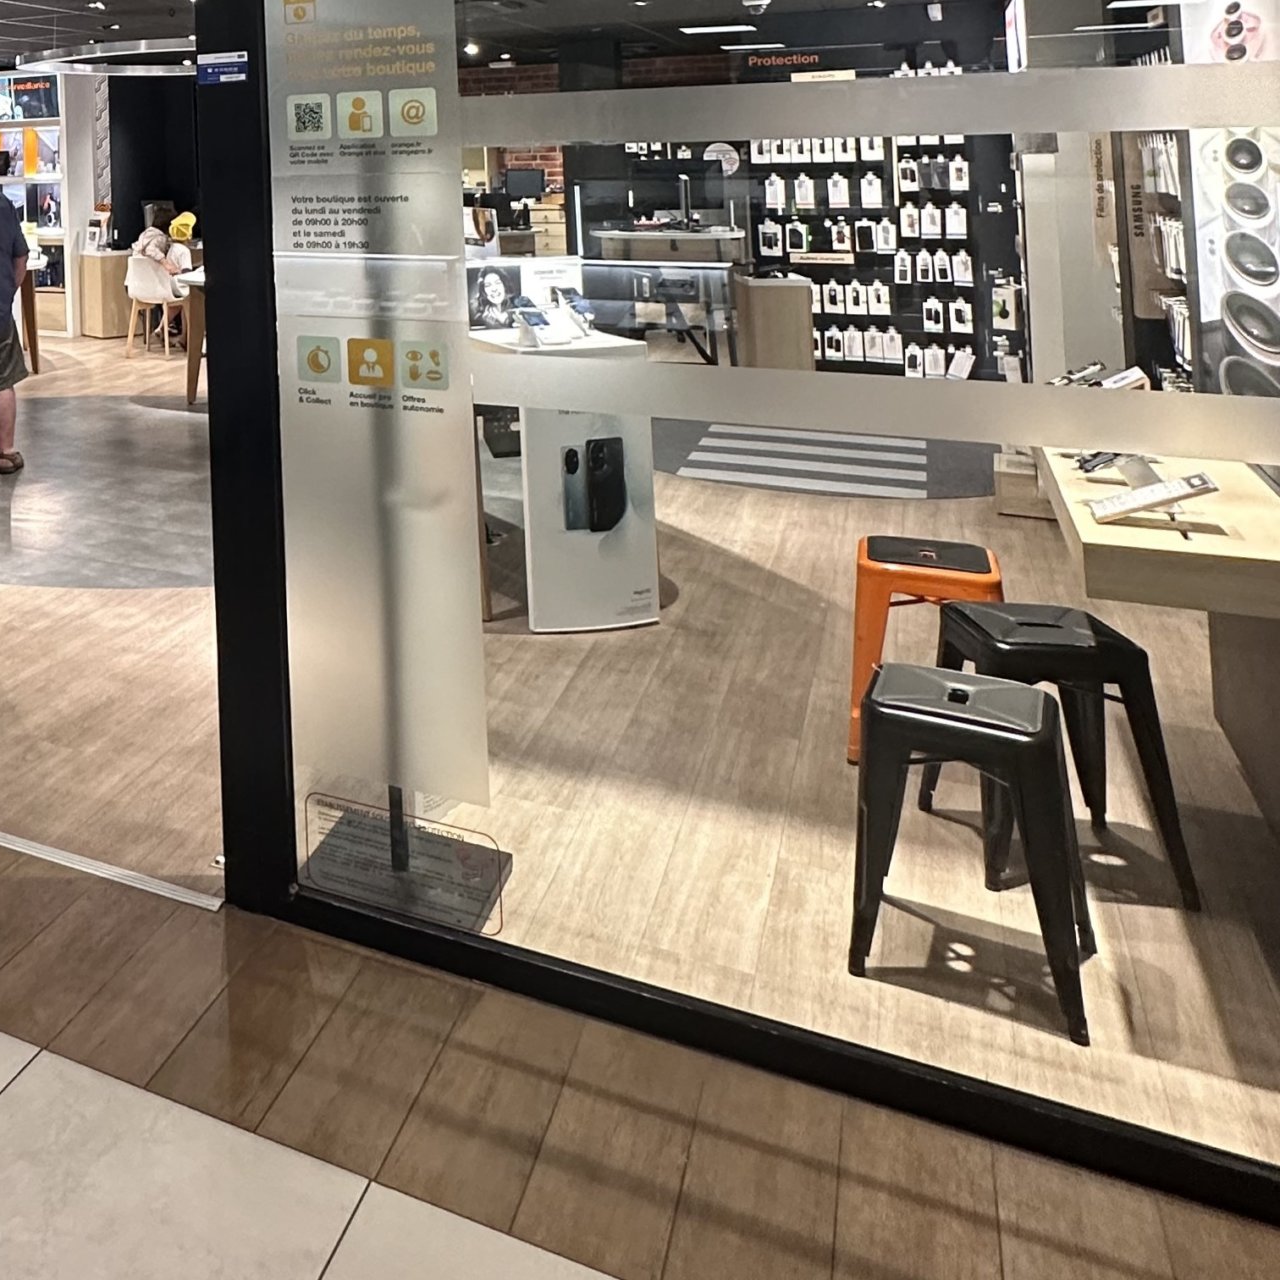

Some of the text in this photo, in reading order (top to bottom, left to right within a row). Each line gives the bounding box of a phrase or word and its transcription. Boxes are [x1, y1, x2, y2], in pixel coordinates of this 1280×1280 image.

[368, 25, 420, 39] temps,
[748, 54, 819, 67] Protection
[366, 60, 435, 76] boutique
[291, 195, 314, 203] Votre
[316, 195, 355, 204] boutique
[374, 195, 409, 203] ouverte
[292, 207, 303, 215] du
[305, 207, 326, 215] lundi
[342, 207, 381, 215] vendredi
[1131, 184, 1144, 237] SAMSUNG
[292, 218, 368, 226] de 09h00 à 20h00
[293, 241, 370, 249] de 09h00 à 19h30
[298, 387, 316, 396] Click
[349, 391, 377, 400] Accueil
[306, 396, 331, 405] Collect
[402, 394, 426, 404] Offres
[402, 404, 444, 414] autonomie
